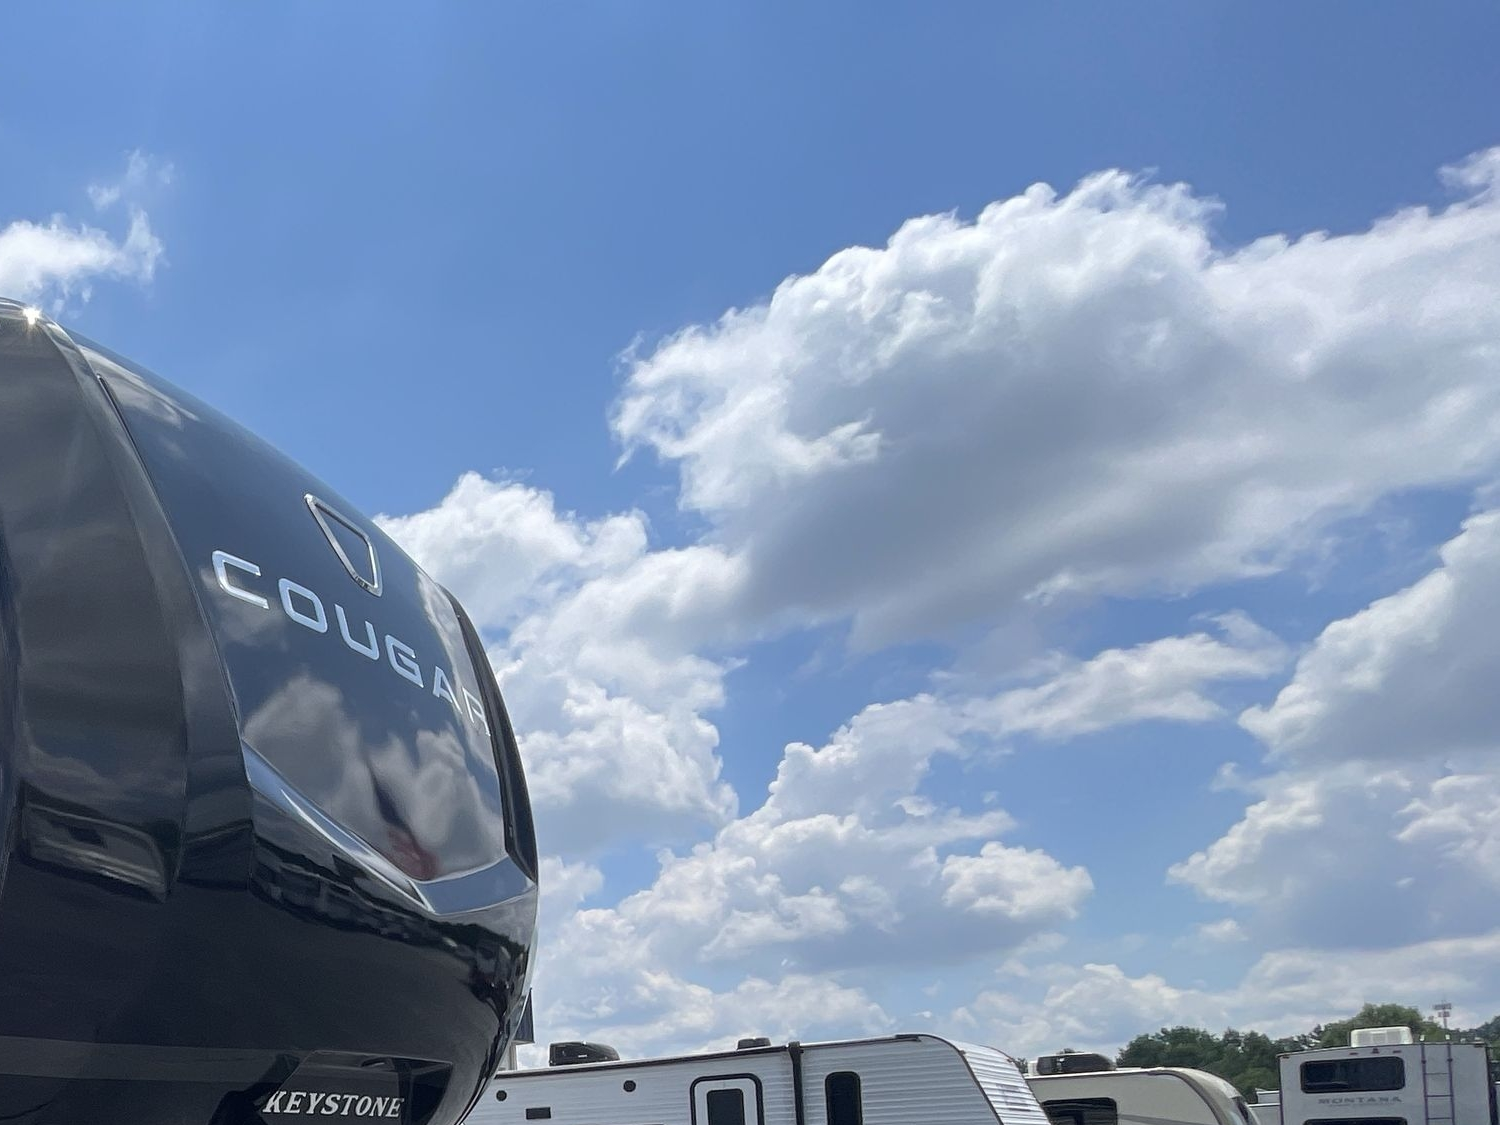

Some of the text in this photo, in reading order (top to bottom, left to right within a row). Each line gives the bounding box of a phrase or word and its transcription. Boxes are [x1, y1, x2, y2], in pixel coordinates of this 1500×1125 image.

[211, 549, 491, 736] COUGAR
[262, 1090, 404, 1118] KEYSTONE
[1318, 1096, 1402, 1105] MONTANA
